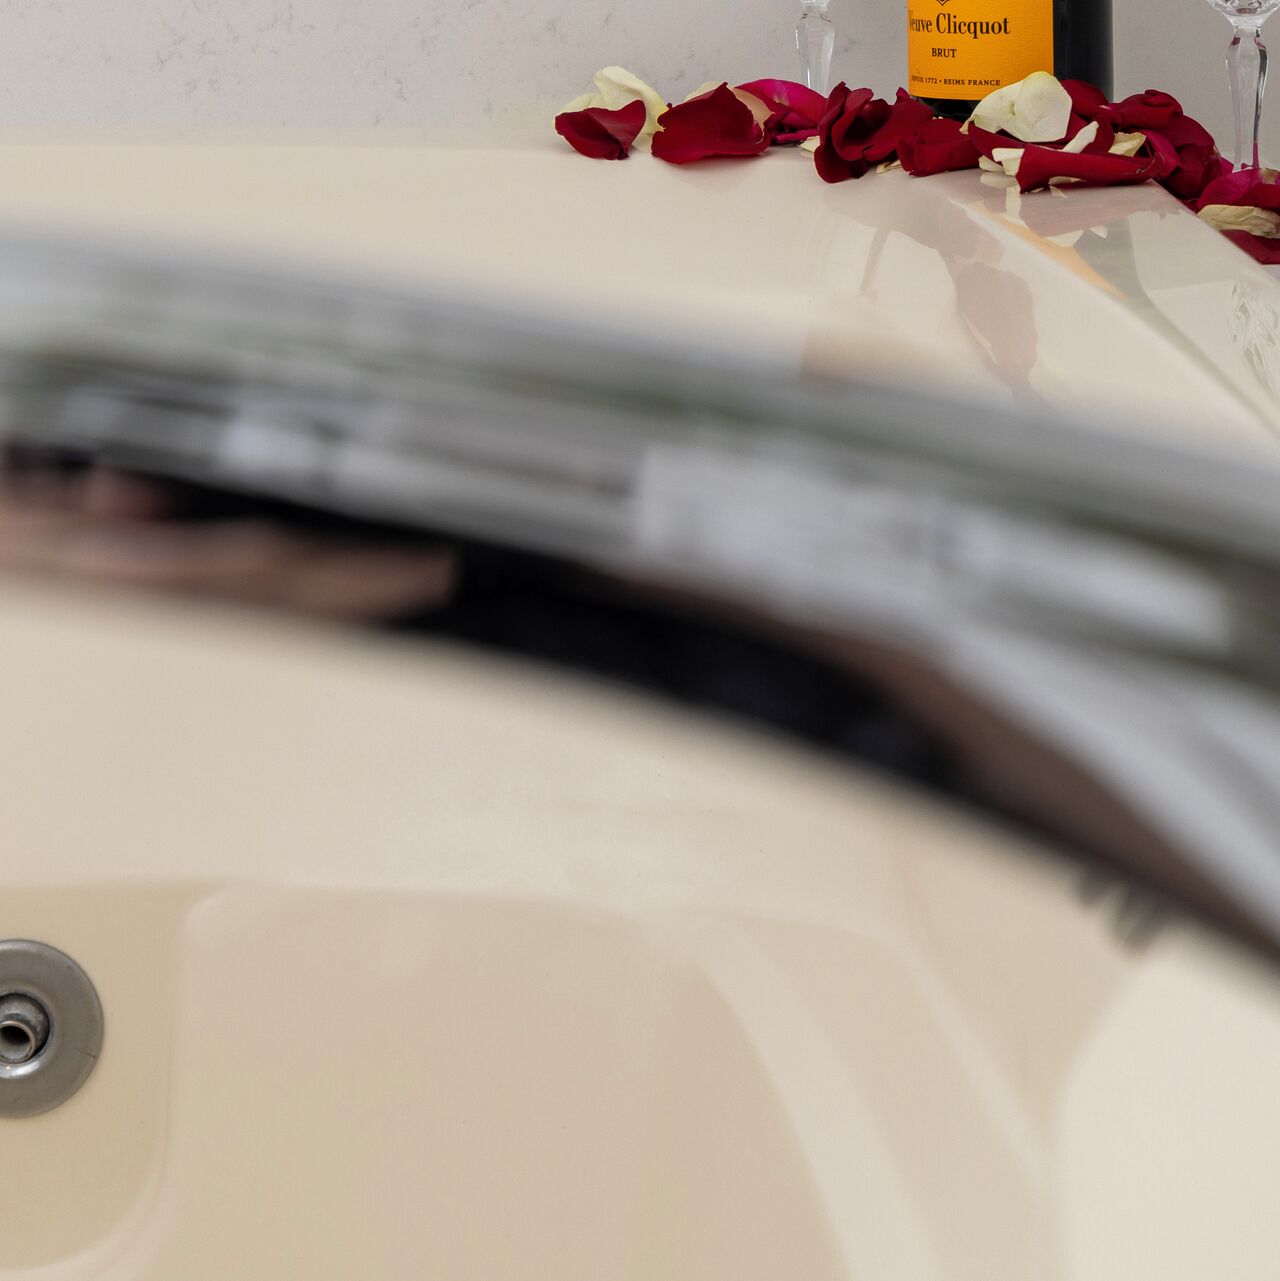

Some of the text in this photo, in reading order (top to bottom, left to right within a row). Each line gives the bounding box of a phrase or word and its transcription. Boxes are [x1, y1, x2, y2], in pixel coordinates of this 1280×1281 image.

[936, 12, 1011, 40] Clicquot
[932, 47, 957, 58] BRUT
[944, 78, 966, 86] REIMS
[968, 79, 1001, 87] FRANCE
